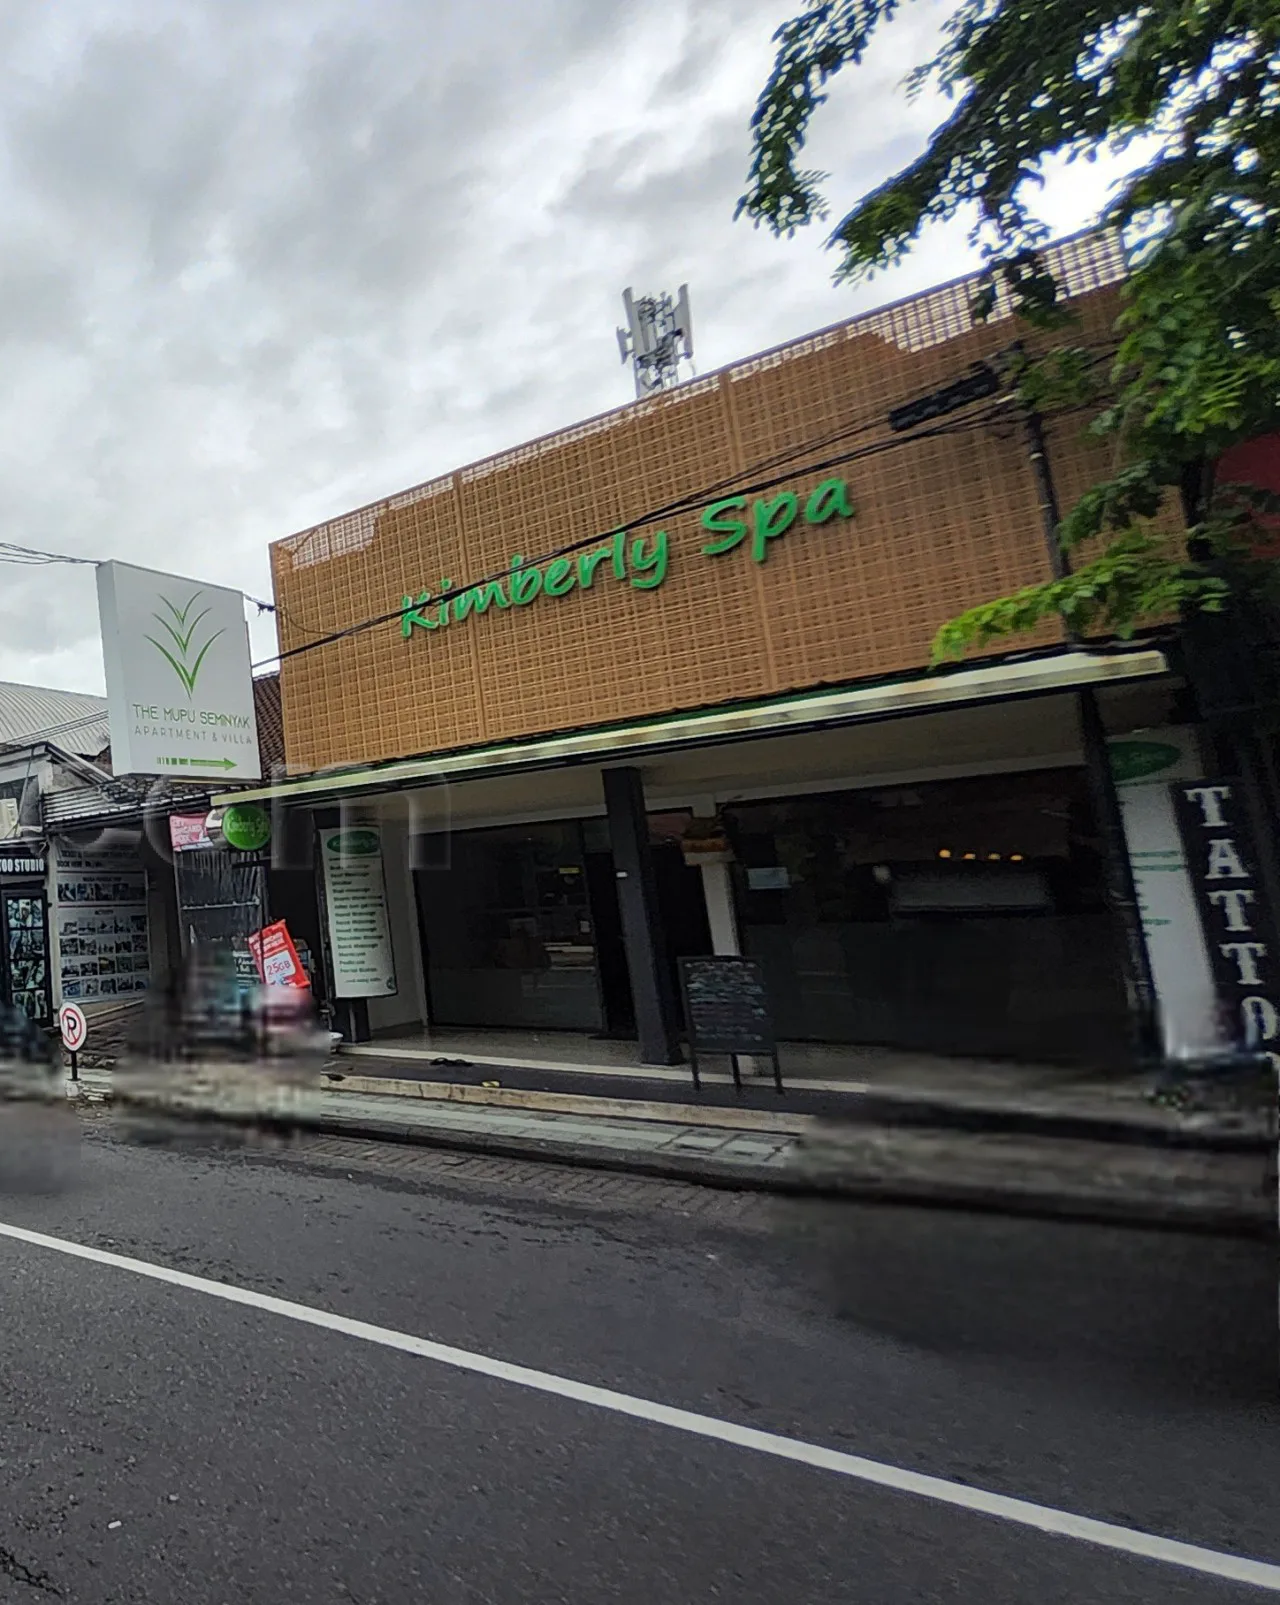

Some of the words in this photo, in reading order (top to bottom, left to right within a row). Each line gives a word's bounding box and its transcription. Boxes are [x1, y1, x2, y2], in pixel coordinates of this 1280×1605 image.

[399, 524, 670, 638] Kimberly
[699, 477, 854, 564] Spa
[132, 703, 159, 720] THE
[163, 707, 196, 724] MUPU
[200, 711, 250, 729] SEMINYAK
[134, 725, 207, 741] APARTMENT
[211, 731, 218, 742] &
[222, 733, 253, 745] VILLA
[14, 858, 45, 873] STUDIO
[267, 960, 291, 976] 25GB
[66, 1015, 77, 1038] P
